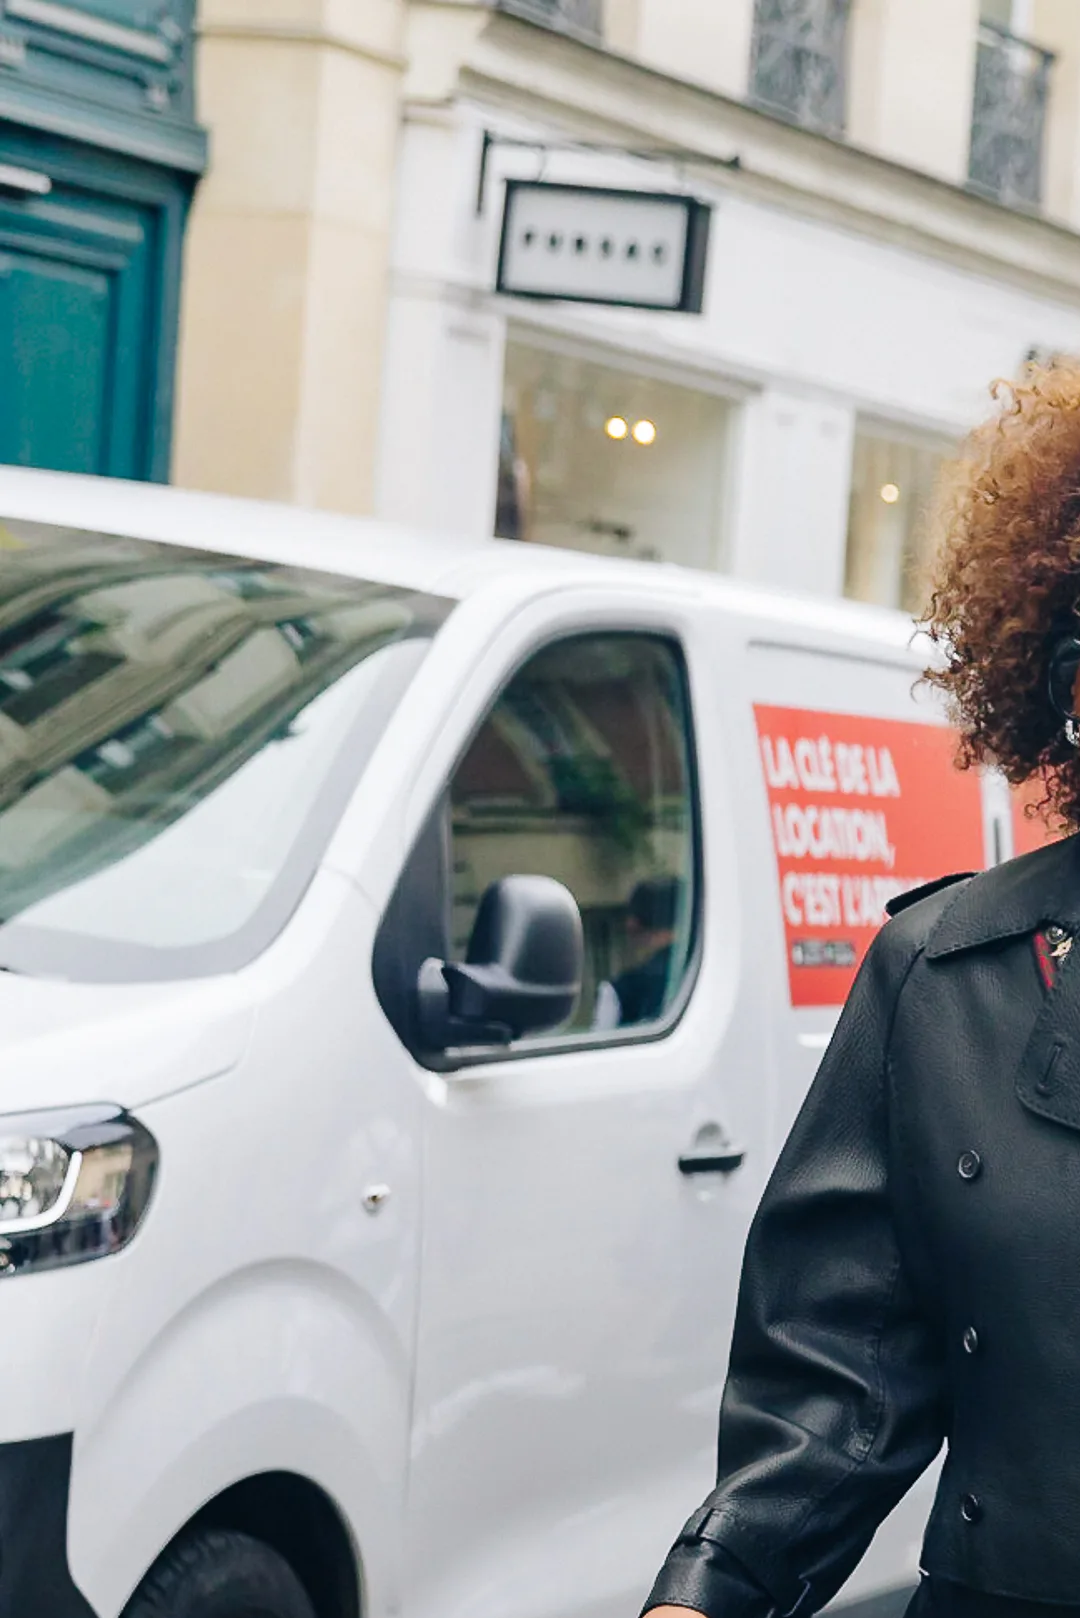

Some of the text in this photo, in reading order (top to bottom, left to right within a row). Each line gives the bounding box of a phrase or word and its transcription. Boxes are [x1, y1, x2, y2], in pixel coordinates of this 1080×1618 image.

[762, 734, 799, 790] LA
[835, 741, 868, 795] DE
[866, 745, 901, 798] LA
[772, 803, 896, 869] LOCATION,
